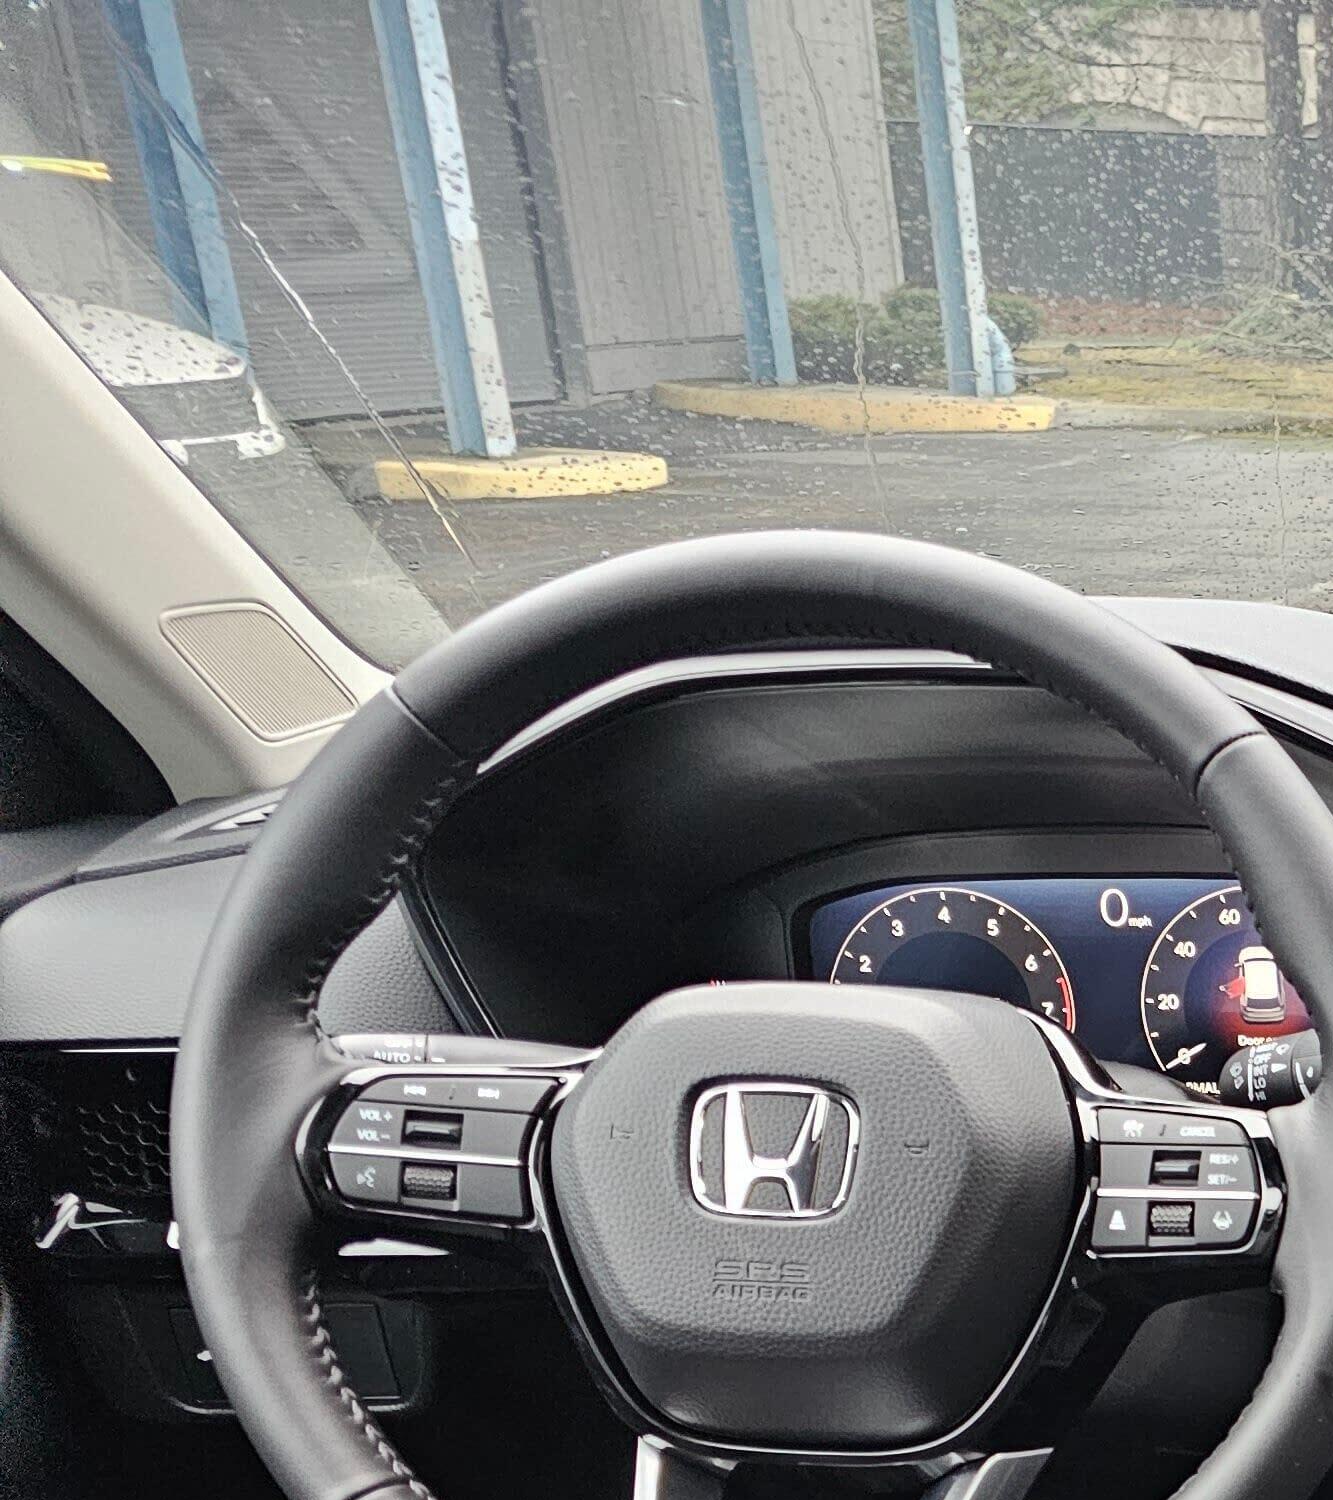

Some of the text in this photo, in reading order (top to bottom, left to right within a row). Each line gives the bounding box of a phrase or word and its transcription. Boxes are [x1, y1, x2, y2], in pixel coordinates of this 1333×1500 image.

[937, 906, 952, 924] 4
[1100, 888, 1153, 929] 0 mph
[1218, 908, 1241, 926] 60
[892, 919, 904, 937] 3
[987, 918, 1000, 937] 5
[1173, 941, 1197, 958] 40
[859, 955, 873, 973] 2
[1024, 954, 1039, 972] 6
[1041, 1001, 1054, 1016] 7
[1157, 993, 1180, 1011] 20
[1253, 1077, 1267, 1089] LO
